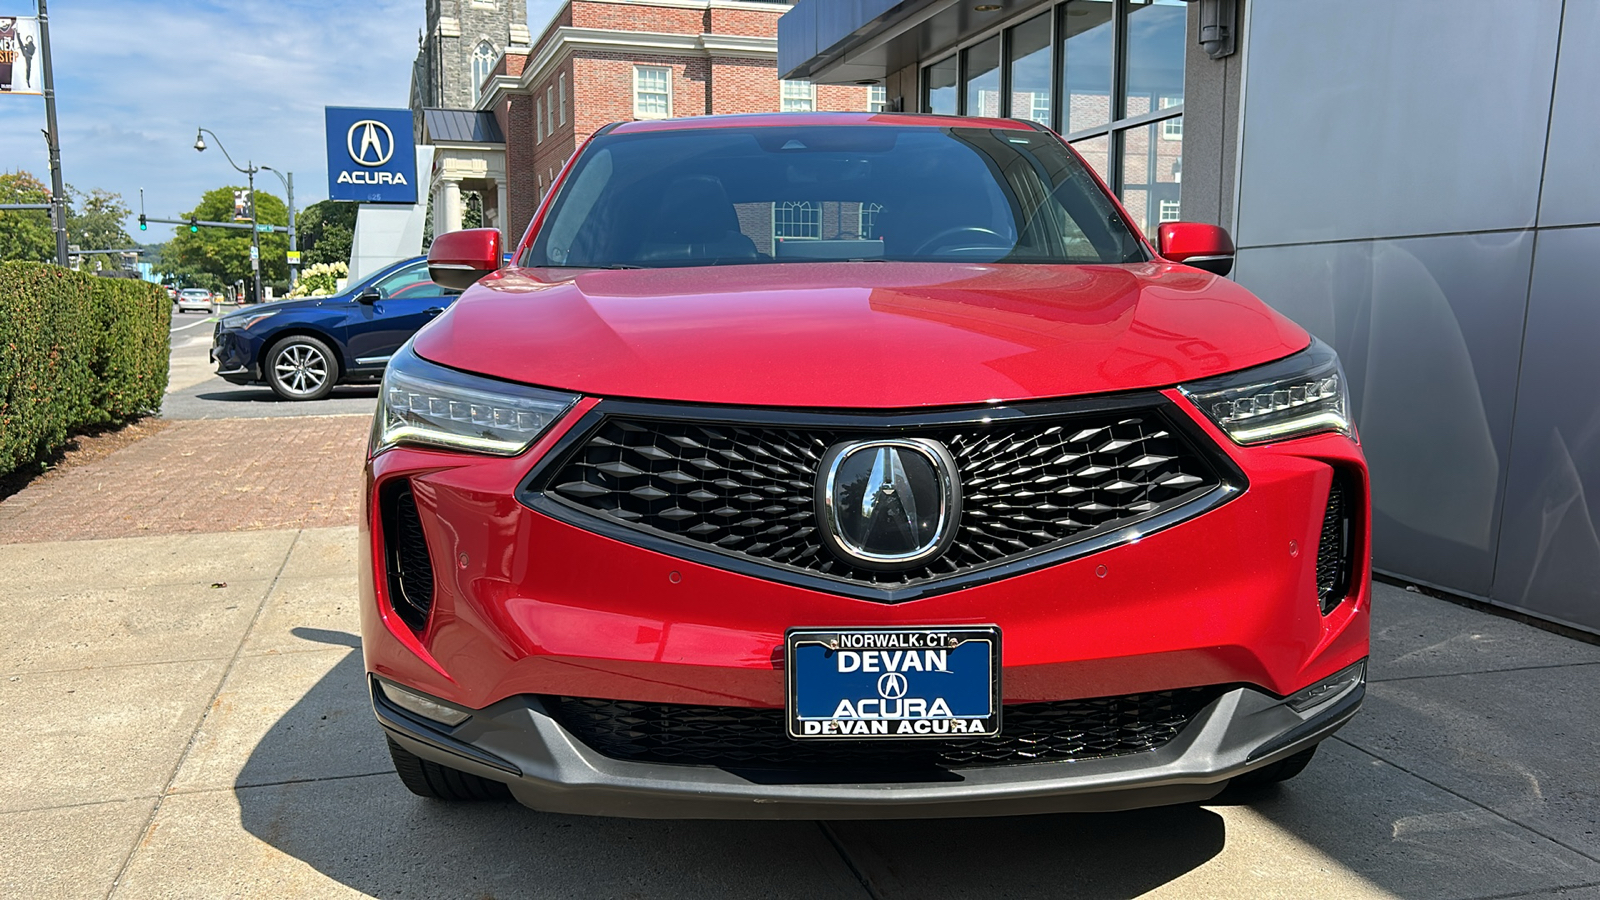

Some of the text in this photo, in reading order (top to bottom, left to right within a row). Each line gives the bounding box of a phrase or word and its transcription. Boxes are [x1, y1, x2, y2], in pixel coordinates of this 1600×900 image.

[0, 50, 19, 63] STEP
[336, 170, 408, 186] ACURA
[840, 633, 947, 648] NORWALK, CT
[837, 649, 947, 673] DEVAN
[831, 697, 954, 718] ACURA
[804, 719, 986, 735] DEVAN ACURA
